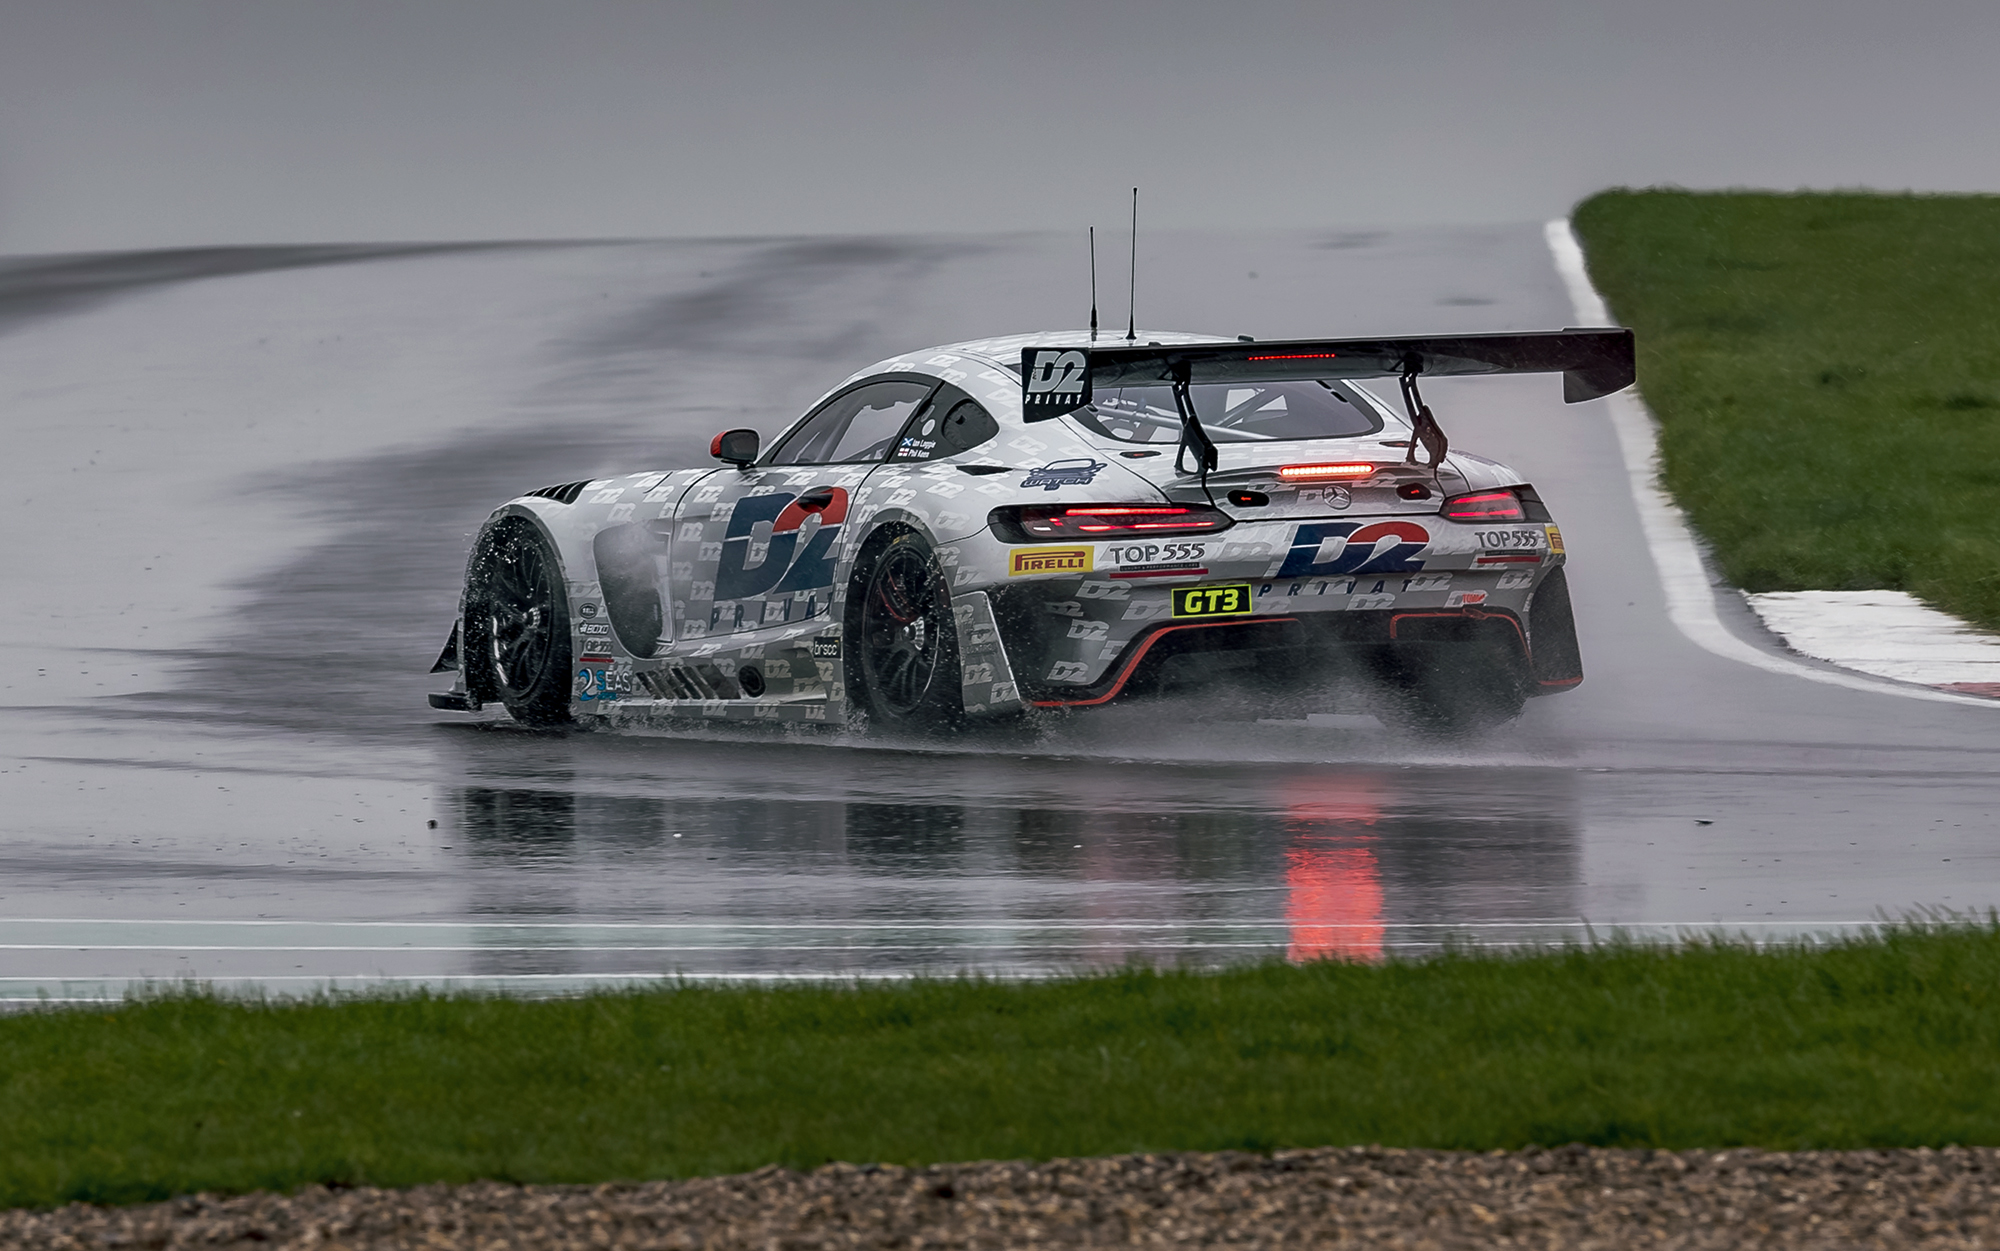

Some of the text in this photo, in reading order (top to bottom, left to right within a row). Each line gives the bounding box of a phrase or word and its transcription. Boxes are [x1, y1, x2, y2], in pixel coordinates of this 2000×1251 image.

[1028, 350, 1086, 393] D2
[1025, 394, 1082, 405] PRIVAT
[693, 486, 724, 503] D2
[677, 522, 704, 542] D2
[1475, 531, 1510, 548] TOP
[1512, 531, 1538, 547] 555
[713, 486, 849, 601] D2
[1109, 543, 1205, 564] TOP 555
[1275, 520, 1431, 579] D2
[1015, 551, 1086, 571] PIRELLI
[1257, 579, 1412, 598] PRIVAT
[1407, 572, 1453, 591] D2
[1496, 569, 1535, 589] D2
[1075, 580, 1132, 600] D2
[1185, 589, 1239, 613] GT3
[1346, 593, 1396, 610] D2
[1067, 618, 1109, 641] D2
[815, 641, 837, 655] brscc
[765, 659, 792, 678] D2
[963, 662, 995, 685] D2
[1047, 660, 1089, 682] D2
